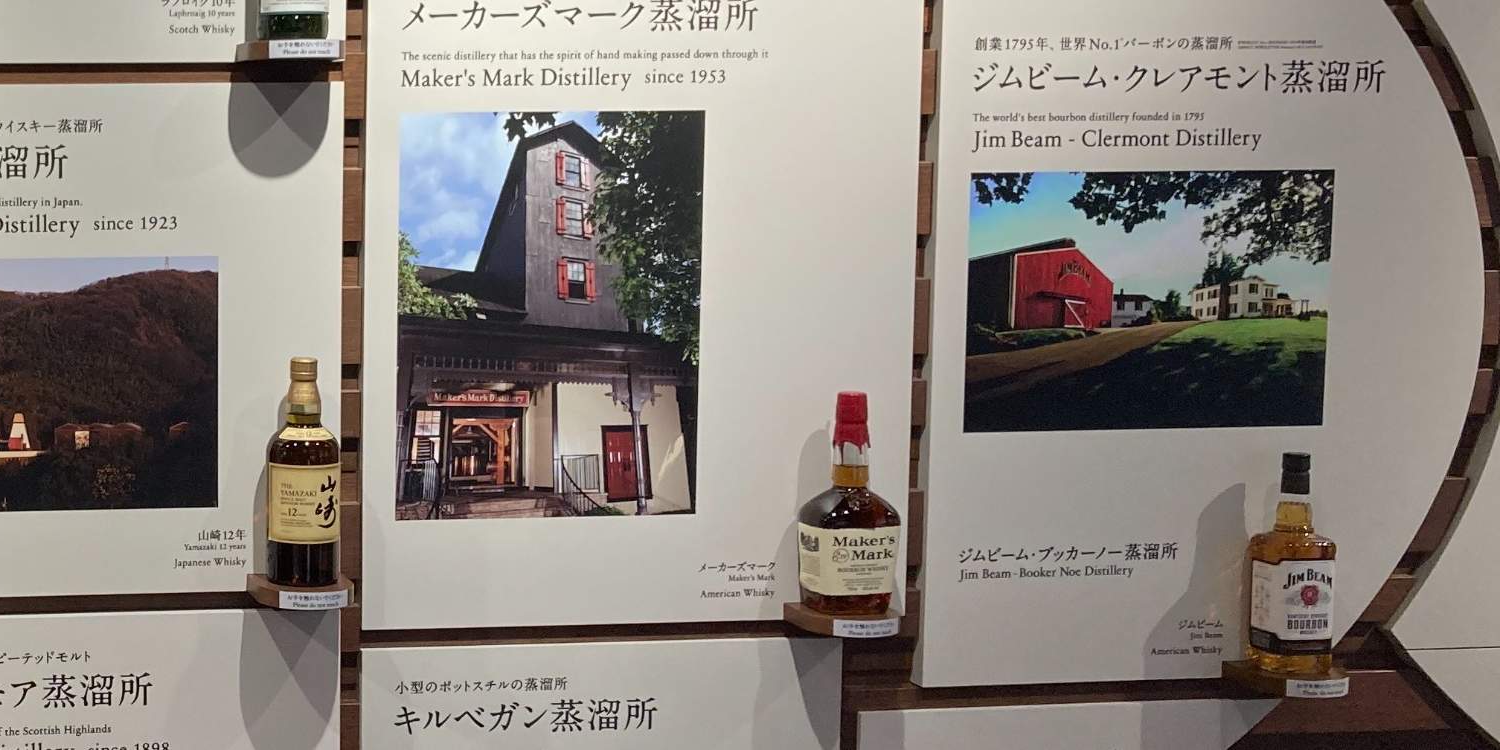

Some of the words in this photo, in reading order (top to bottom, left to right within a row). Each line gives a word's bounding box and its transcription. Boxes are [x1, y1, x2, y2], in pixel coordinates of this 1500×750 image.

[403, 0, 758, 31] メーカーズマーク蒸溜所
[169, 25, 198, 34] Scotch
[202, 24, 235, 36] Whisky
[402, 51, 419, 61] The
[454, 51, 496, 63] distillery
[499, 51, 518, 60] that
[521, 50, 536, 60] has
[540, 50, 554, 60] the
[557, 50, 581, 62] spirit
[584, 50, 595, 60] of
[597, 50, 619, 59] hand
[623, 50, 658, 62] making
[660, 49, 690, 61] passed
[693, 49, 718, 59] down
[722, 49, 758, 61] through
[762, 49, 768, 58] it
[402, 68, 475, 87] Maker's
[483, 67, 533, 86] Mark
[541, 67, 631, 91] Distillery
[645, 70, 683, 83] since
[692, 70, 725, 83] 1953
[974, 60, 1386, 93] ジムビーム・クレアモント蒸溜所
[972, 113, 990, 122] The
[993, 112, 1024, 122] world's
[1028, 113, 1046, 122] best
[1049, 112, 1086, 121] bourbon
[1089, 112, 1129, 123] distillery
[1132, 112, 1169, 121] founded
[1172, 112, 1181, 121] in
[1185, 112, 1204, 120] 1795
[972, 130, 1005, 152] Jim
[1012, 131, 1061, 147] Beam
[1082, 129, 1169, 147] Clermont
[1176, 128, 1261, 151] Distillery
[52, 197, 82, 208] Japan.
[94, 216, 133, 230] since
[141, 216, 177, 231] 1923
[288, 507, 298, 517] 12
[199, 529, 245, 541] 山崎12年
[832, 536, 895, 546] Maker's
[184, 543, 217, 551] Yamazaki
[228, 542, 246, 551] years
[852, 549, 893, 560] Mark
[174, 559, 211, 568] Japanese
[213, 557, 246, 568] Whisky
[699, 561, 776, 573] メーカーズマーク
[728, 574, 755, 582] Maker's
[958, 569, 978, 582] Jim
[982, 569, 1011, 579] Beam
[1020, 567, 1056, 577] Booker
[1059, 566, 1081, 576] Noe
[1085, 565, 1133, 577] Distillery
[701, 590, 740, 598] American
[744, 588, 774, 598] Whisky
[1151, 648, 1190, 656] American
[1192, 646, 1222, 655] Whisky
[395, 677, 567, 694] 小型のポットスチルの蒸溜所
[394, 698, 657, 735] キルベガン蒸溜所
[5, 727, 20, 736] the
[23, 725, 61, 735] Scottish
[64, 724, 111, 736] Highlands
